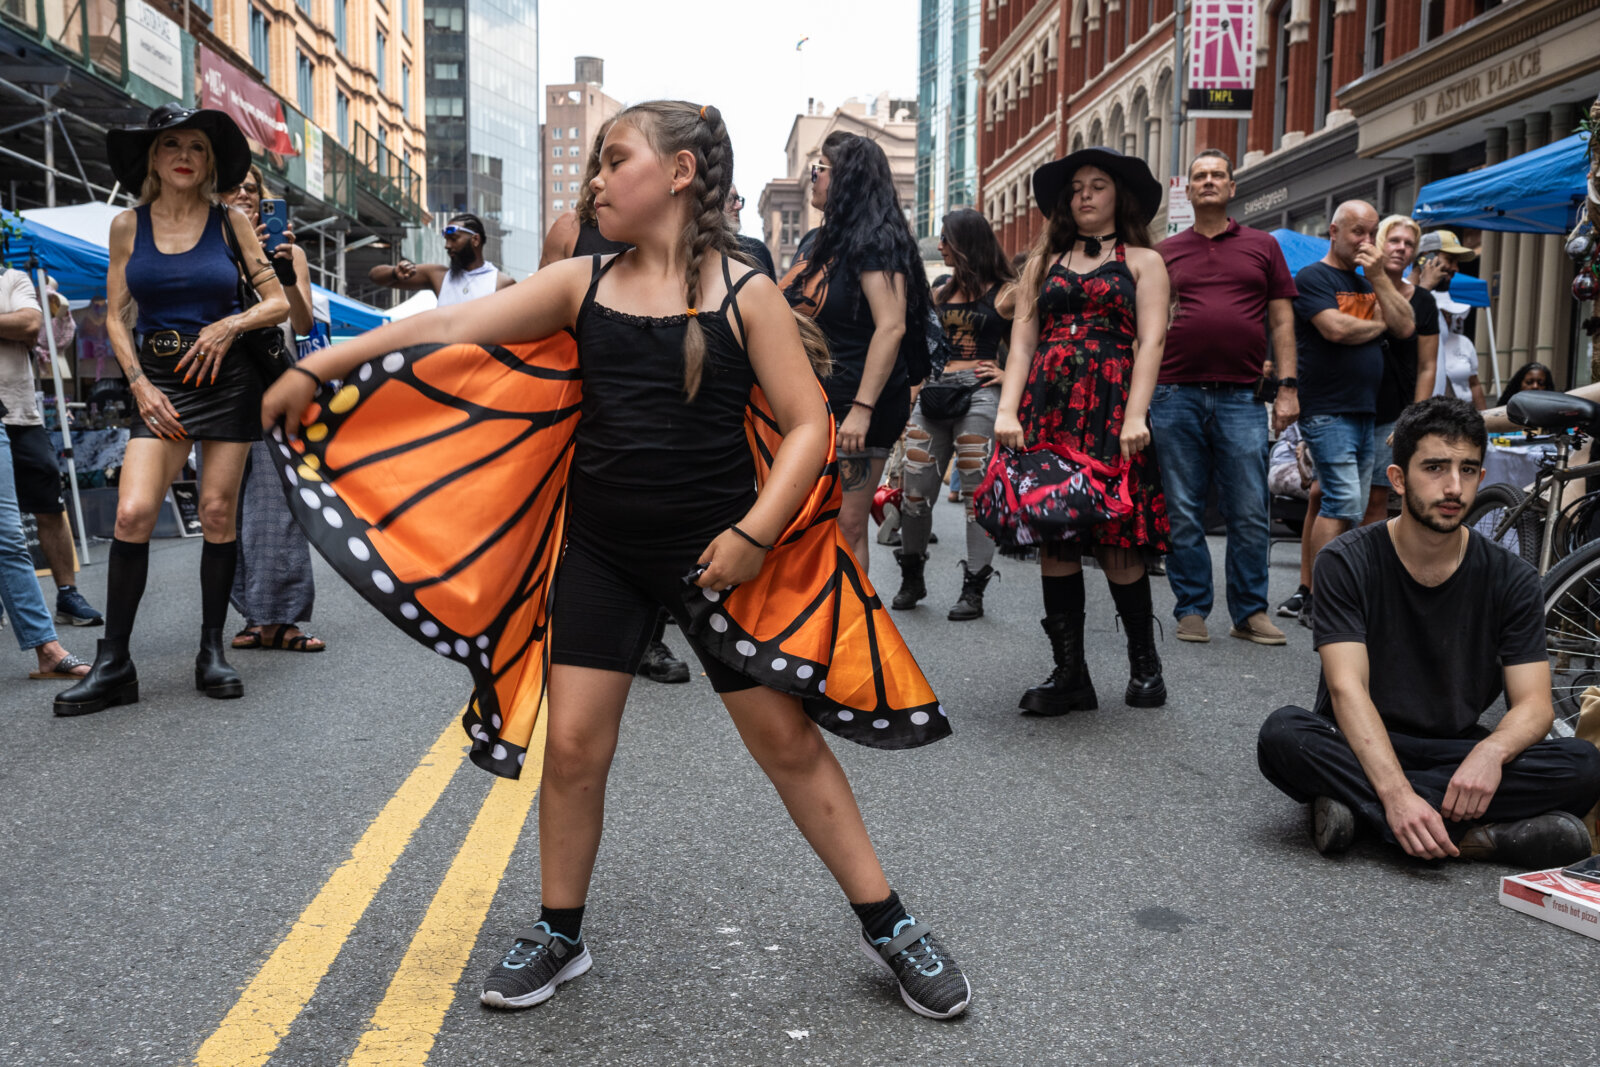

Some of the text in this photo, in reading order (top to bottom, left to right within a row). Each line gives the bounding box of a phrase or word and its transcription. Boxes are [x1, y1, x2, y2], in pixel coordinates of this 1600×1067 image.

[1209, 90, 1234, 102] TMPL
[1413, 48, 1542, 126] 10 ASTOR PLACE
[1244, 187, 1288, 215] sweetgreen
[1552, 900, 1598, 924] fresh hot pizza
